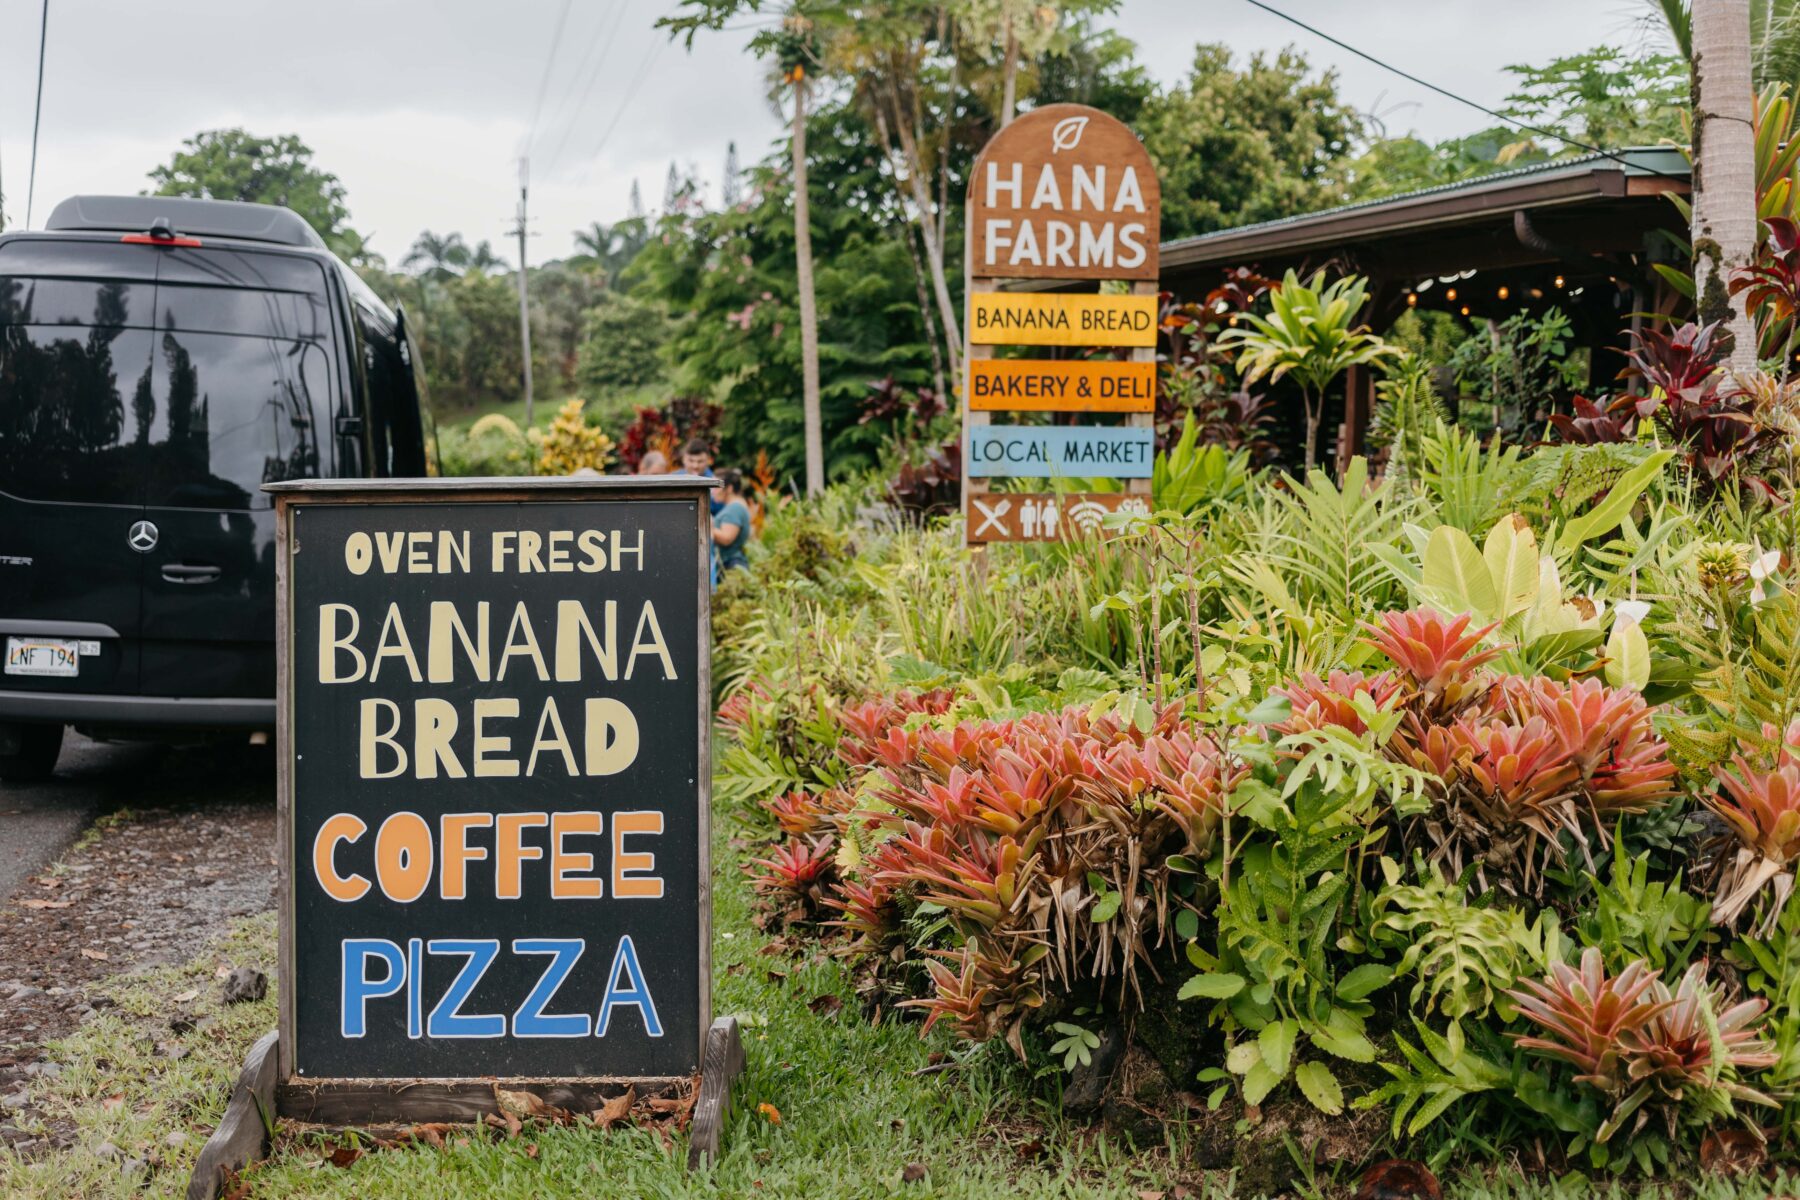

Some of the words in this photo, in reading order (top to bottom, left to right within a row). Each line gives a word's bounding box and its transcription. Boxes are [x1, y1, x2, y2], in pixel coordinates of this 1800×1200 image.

[986, 162, 1146, 213] HANA
[985, 219, 1147, 268] FARMS
[976, 307, 1070, 329] BANANA
[1082, 309, 1150, 331] BREAD
[975, 375, 1069, 397] BAKERY
[1077, 376, 1092, 397] &
[1100, 377, 1151, 399] DELI
[972, 440, 1050, 462] LOCAL
[1063, 441, 1150, 463] MARKET
[345, 530, 471, 575] OVEN
[491, 529, 645, 573] FRESH
[10, 647, 38, 666] LNF
[50, 648, 75, 667] 194
[319, 600, 678, 683] BANANA
[359, 696, 640, 779] BREAD
[313, 811, 664, 903] COFFEE
[341, 934, 664, 1038] PIZZA
